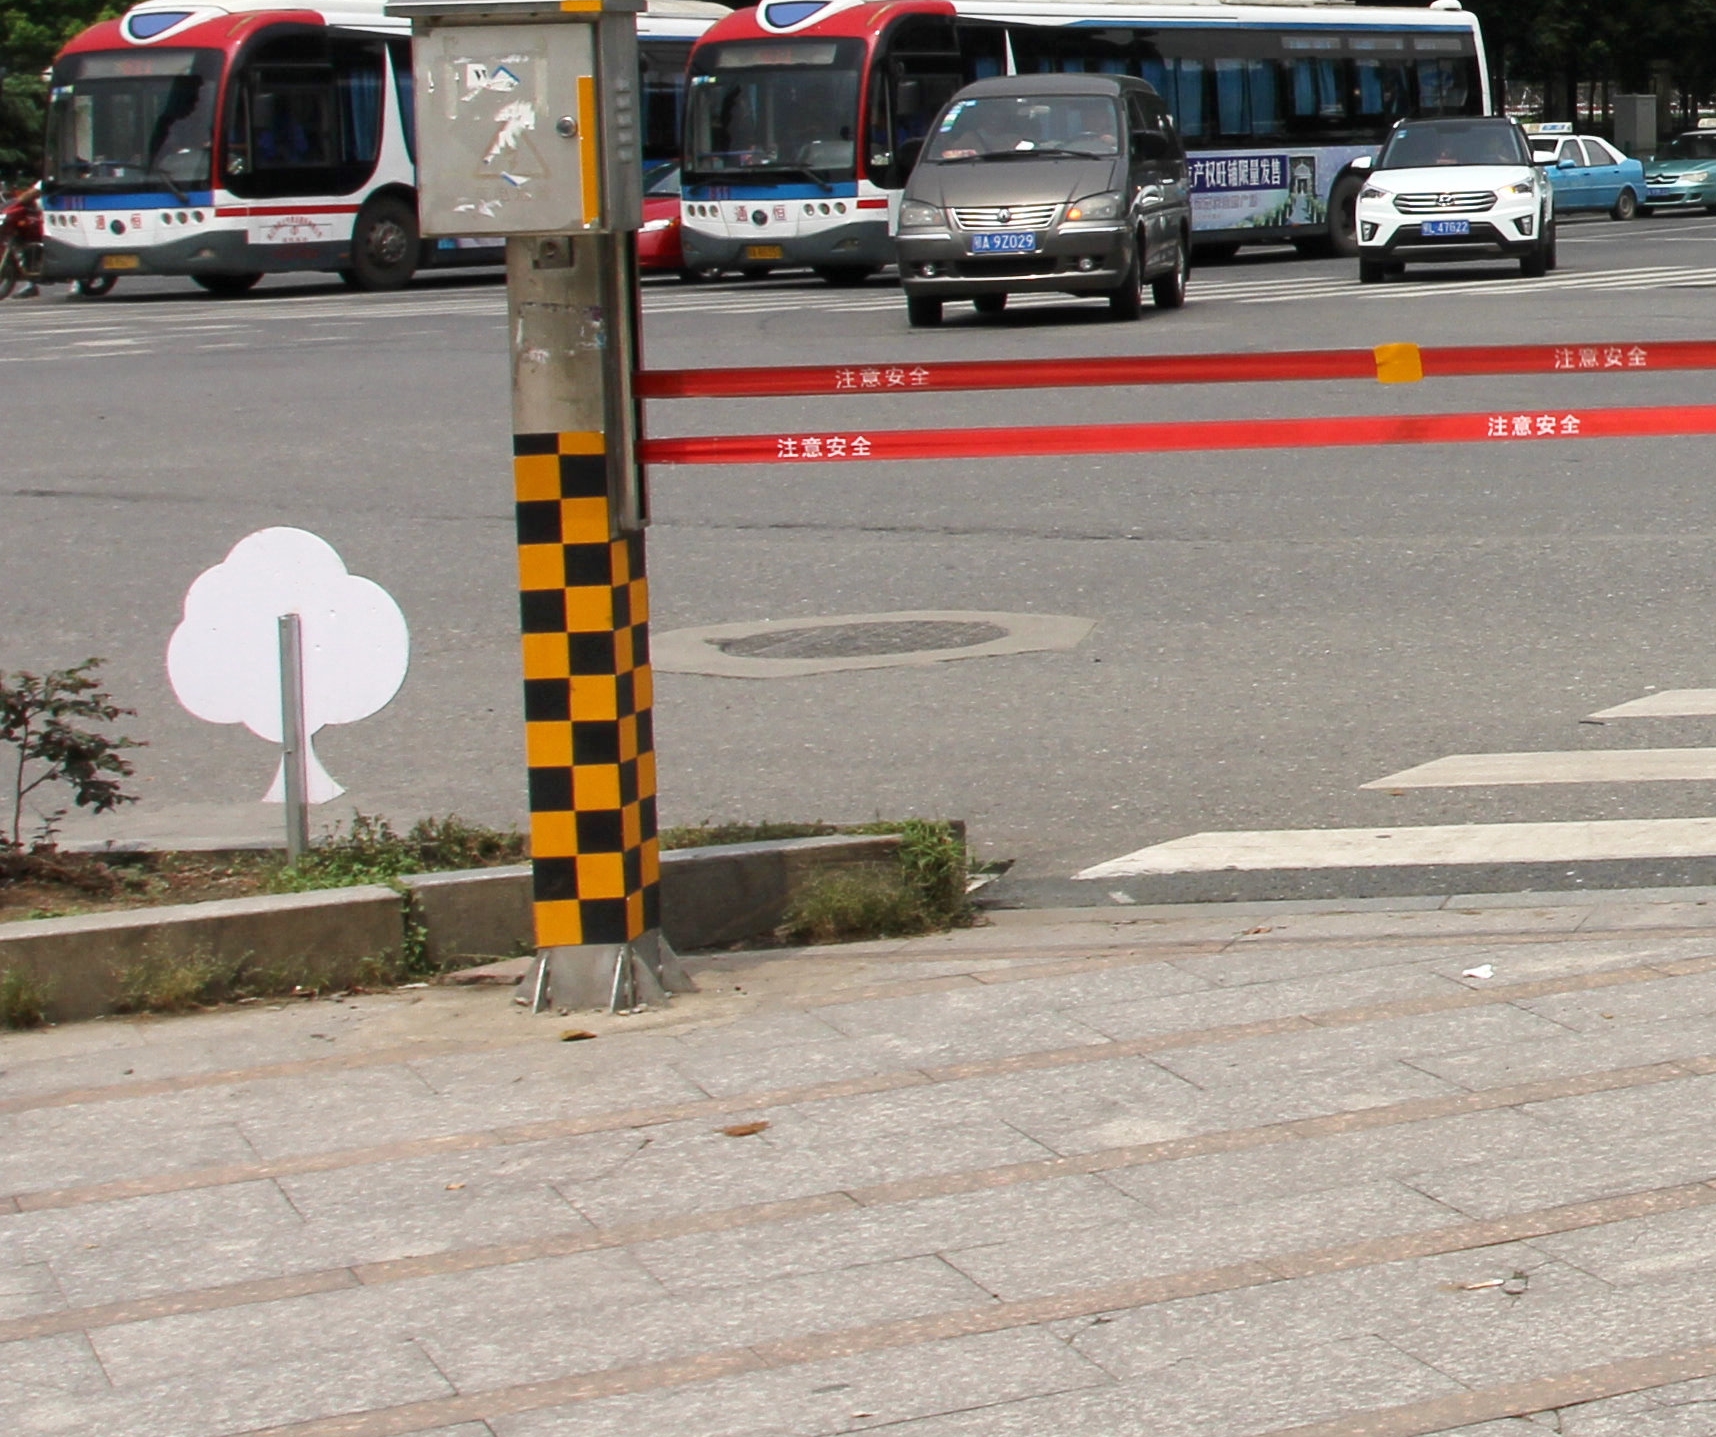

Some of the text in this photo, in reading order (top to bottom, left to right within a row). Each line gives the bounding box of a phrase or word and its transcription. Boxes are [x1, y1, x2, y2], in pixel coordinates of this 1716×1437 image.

[1554, 346, 1647, 369] 注意安全
[834, 366, 930, 389] 注意安全
[1487, 414, 1580, 436] 注意安全
[777, 435, 871, 458] 注意安全
